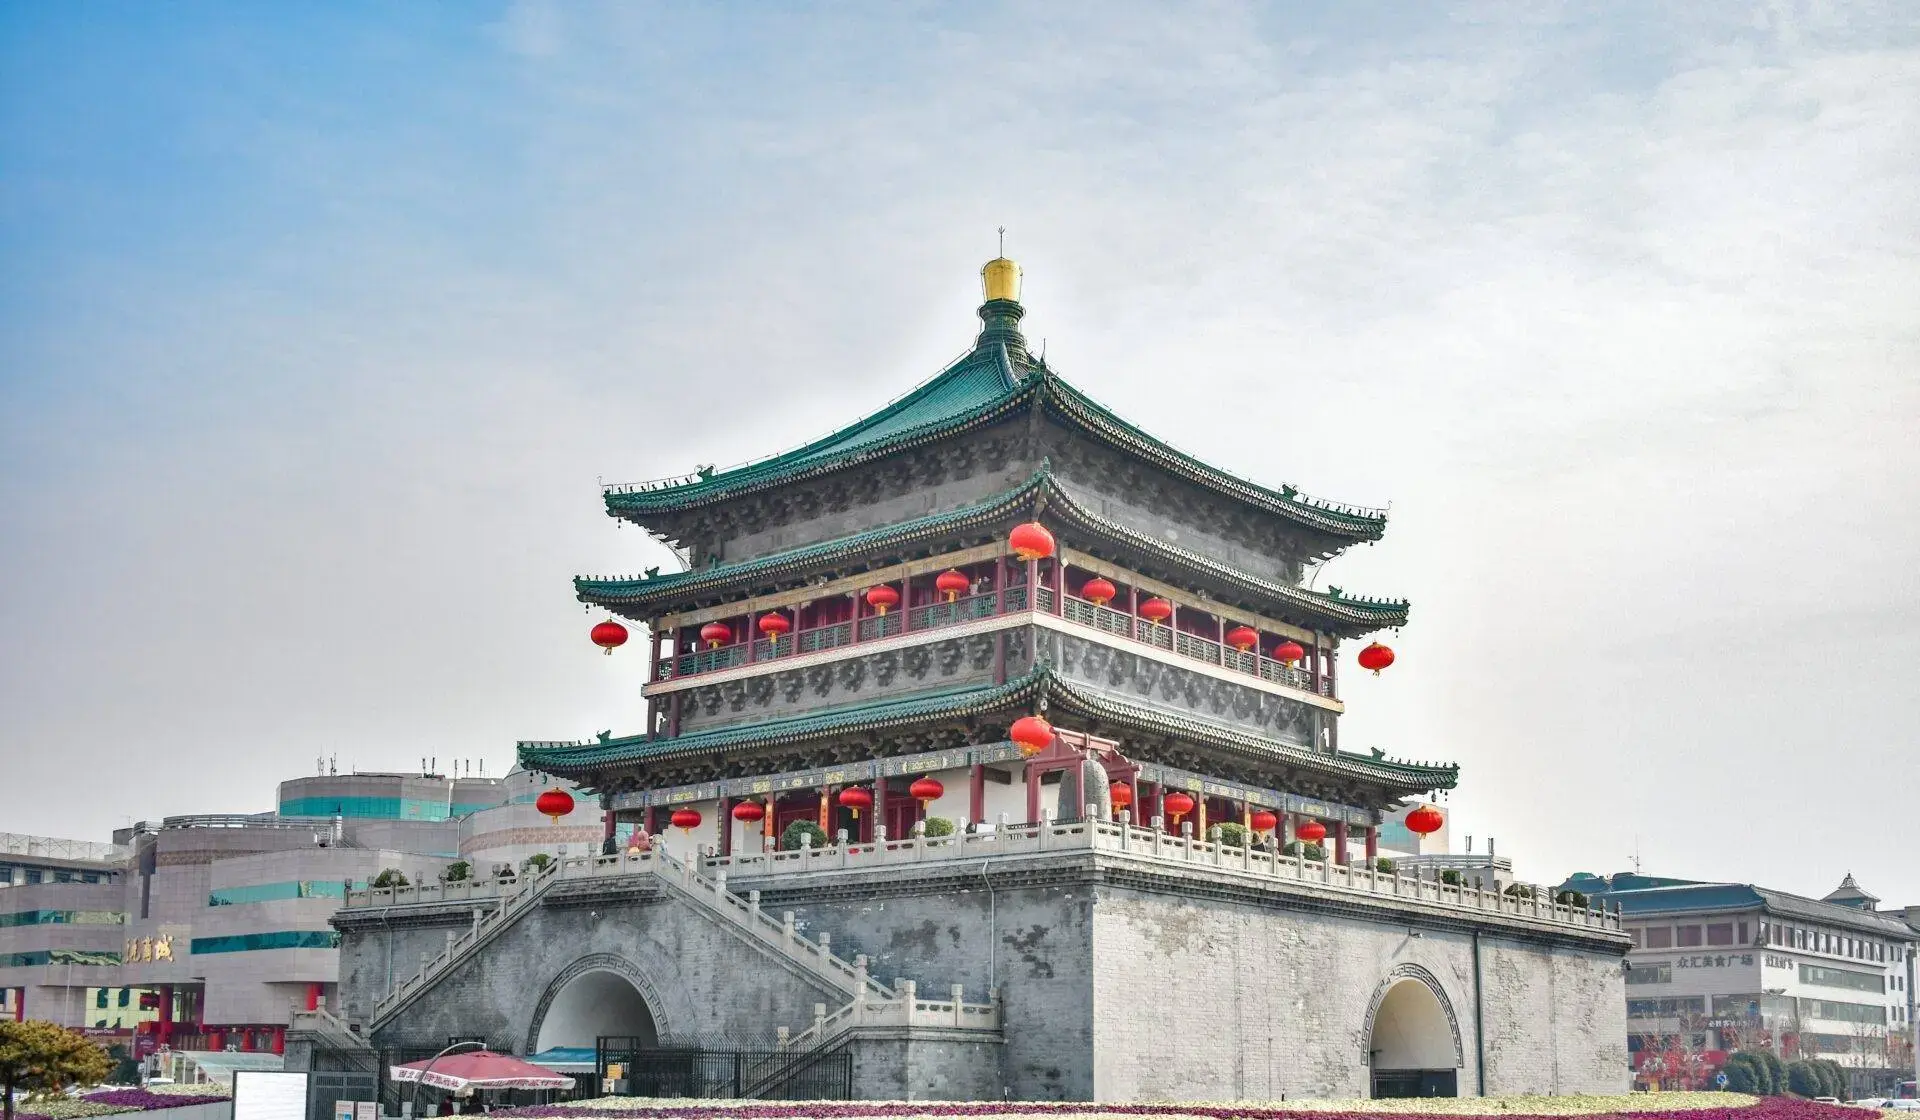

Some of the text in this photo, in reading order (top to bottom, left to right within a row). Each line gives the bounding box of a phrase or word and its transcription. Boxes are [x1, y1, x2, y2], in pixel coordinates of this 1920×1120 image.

[1677, 955, 1754, 968] 众汇美食广场
